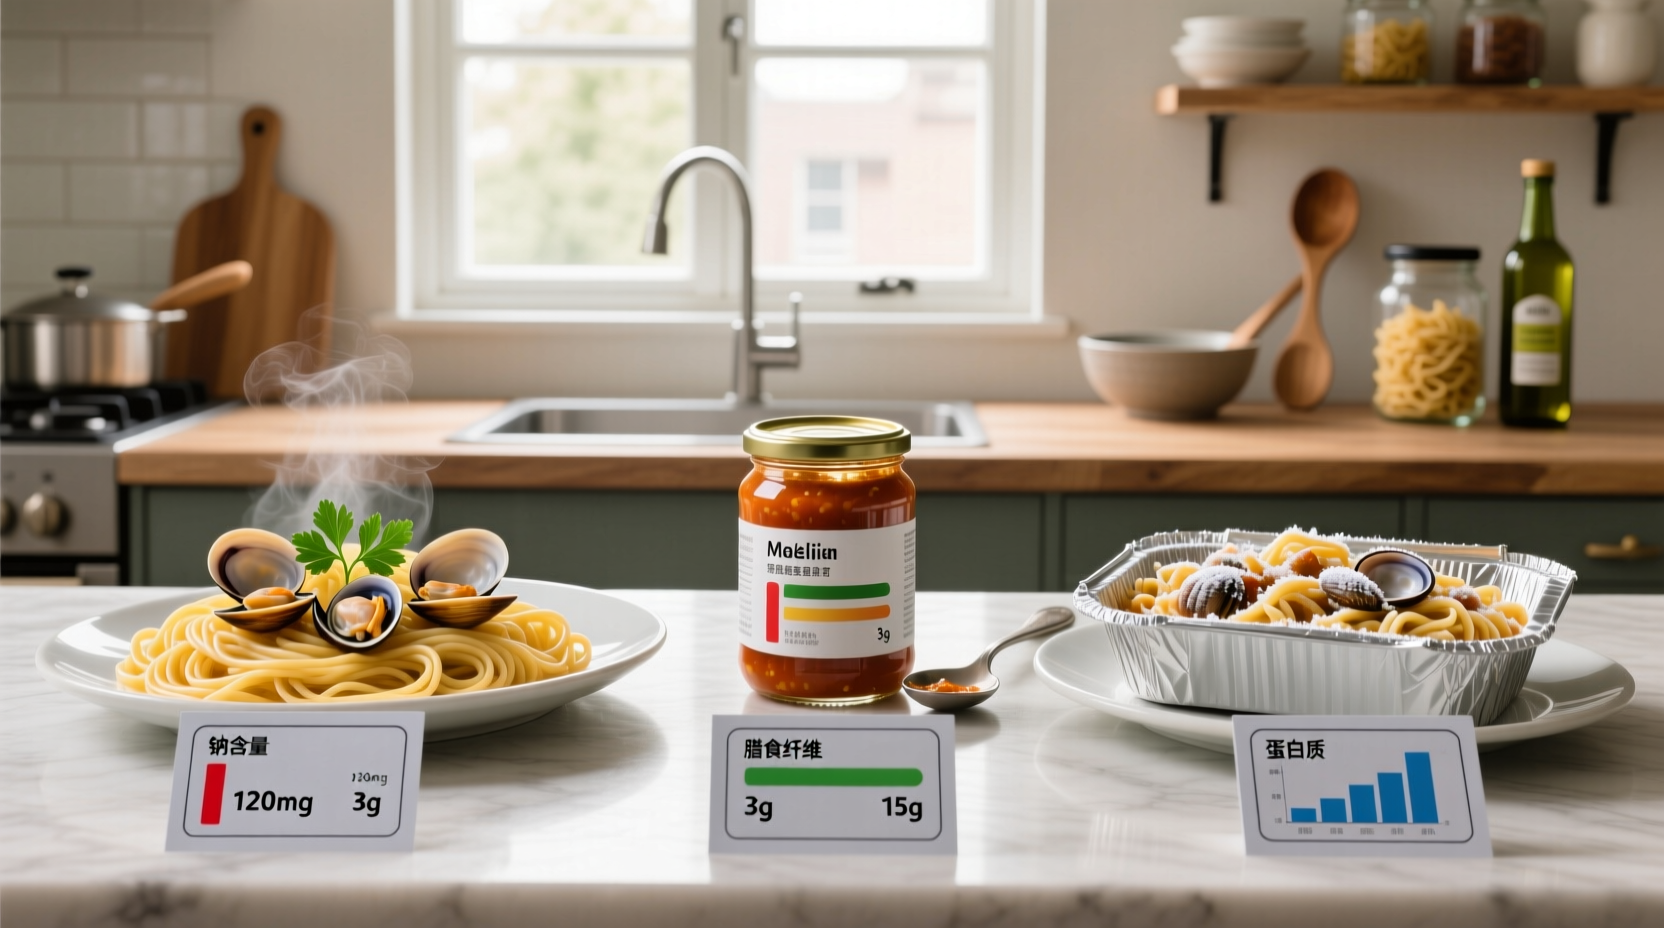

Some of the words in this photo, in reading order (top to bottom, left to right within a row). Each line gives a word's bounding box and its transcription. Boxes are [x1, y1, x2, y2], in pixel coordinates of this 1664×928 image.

[877, 627, 891, 644] 3g
[208, 734, 270, 757] 钠含量
[1265, 738, 1326, 760] 蛋白质
[233, 790, 314, 818] 120mg
[352, 791, 382, 818] 3g
[744, 795, 773, 823] 3g
[881, 796, 923, 823] 15g
